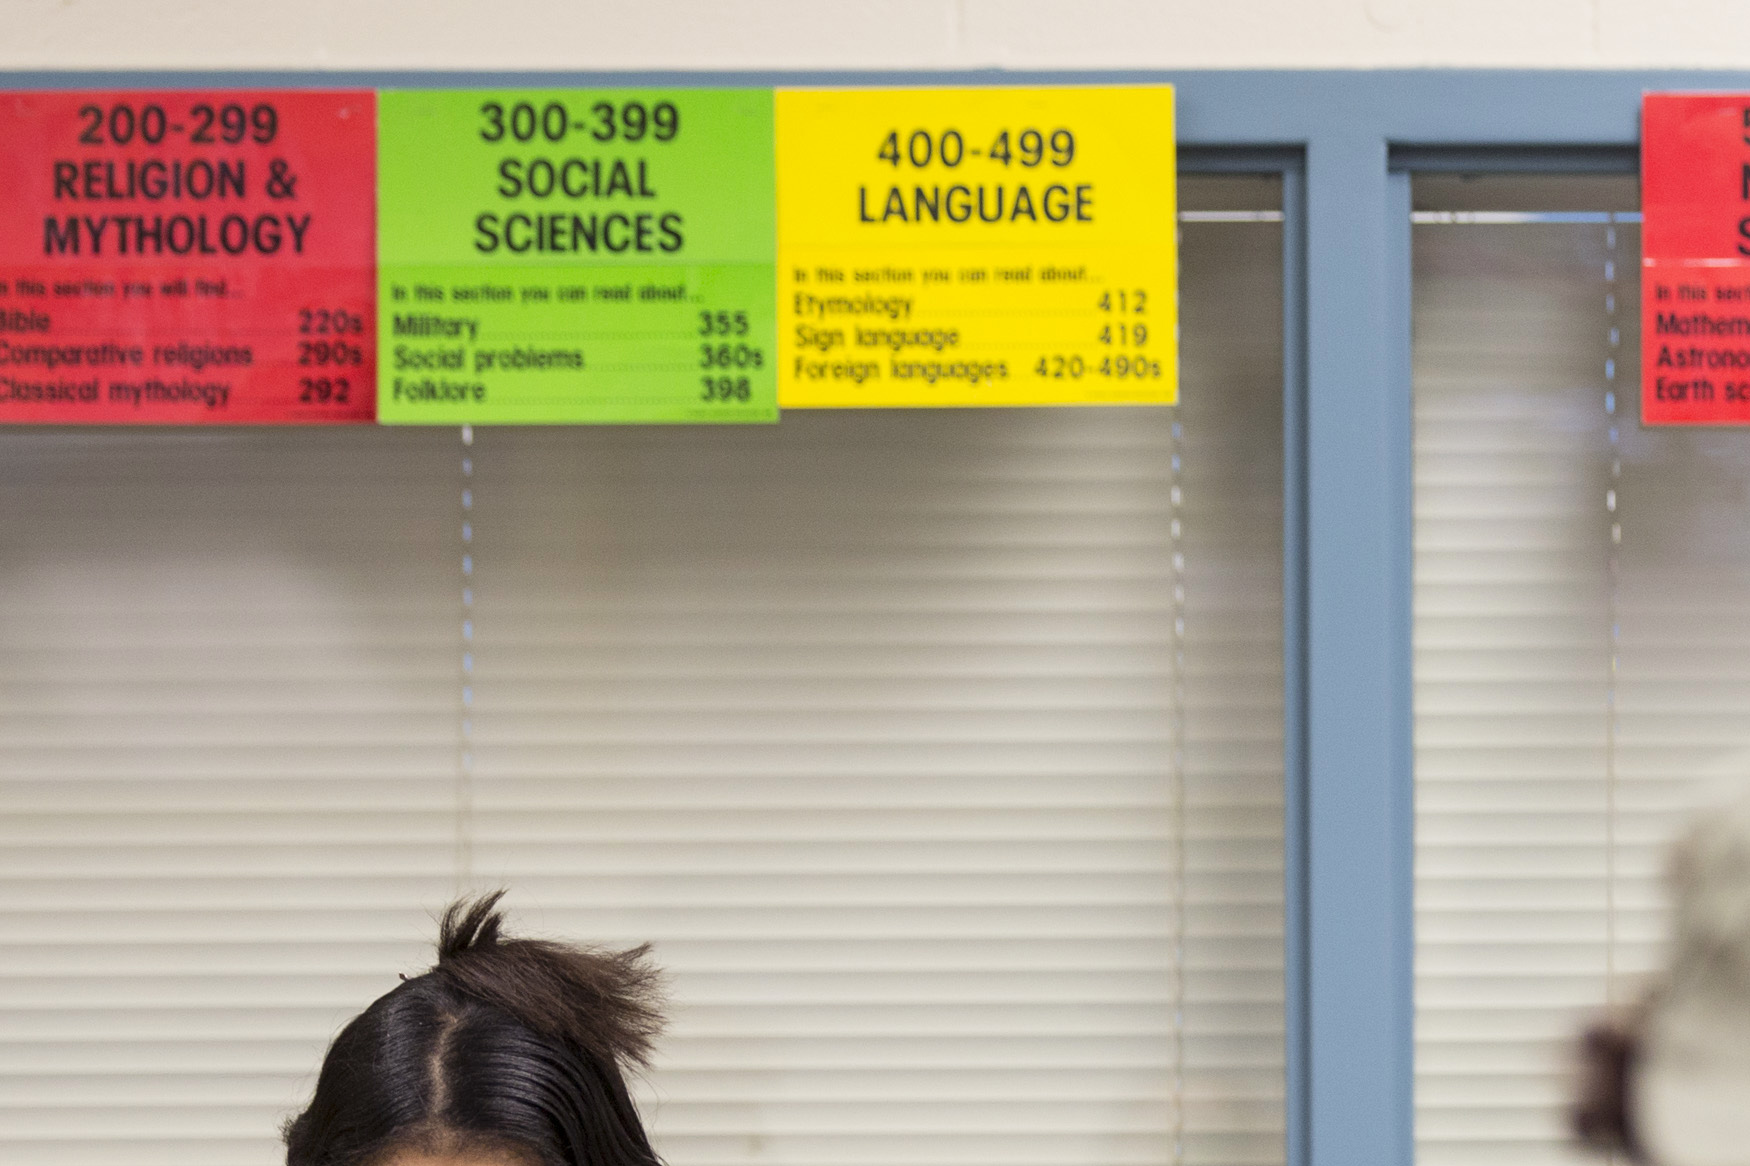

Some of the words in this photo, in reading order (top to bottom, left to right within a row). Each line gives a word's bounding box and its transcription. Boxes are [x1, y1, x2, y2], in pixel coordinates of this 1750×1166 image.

[78, 104, 278, 145] 200-299
[479, 101, 680, 142] 300-399
[877, 128, 1076, 168] 400-499
[54, 159, 246, 199] RELIGION
[265, 158, 297, 199] &
[497, 157, 656, 199] SOCIAL
[858, 183, 1094, 223] LANGUAGE
[44, 213, 311, 255] MYTHOLOGY
[474, 212, 684, 254] SCIENCES
[794, 292, 913, 320] Etymology
[1099, 290, 1148, 315] 412
[298, 308, 363, 335] 220s
[393, 312, 479, 340] Military
[699, 310, 748, 337] 355
[794, 325, 844, 352] Sign
[855, 324, 959, 352] language
[1099, 323, 1148, 348] 419
[153, 341, 253, 371] religions
[298, 341, 363, 366] 290s
[393, 345, 463, 370] Social
[474, 346, 584, 374] problems
[699, 344, 763, 369] 360s
[794, 357, 880, 384] Foreign
[890, 356, 1008, 384] languages
[1034, 355, 1162, 380] 420-490s
[109, 378, 230, 409] mythology
[298, 377, 349, 404] 292
[393, 377, 486, 402] Folklore
[700, 376, 751, 402] 398
[1655, 377, 1714, 402] Earth
